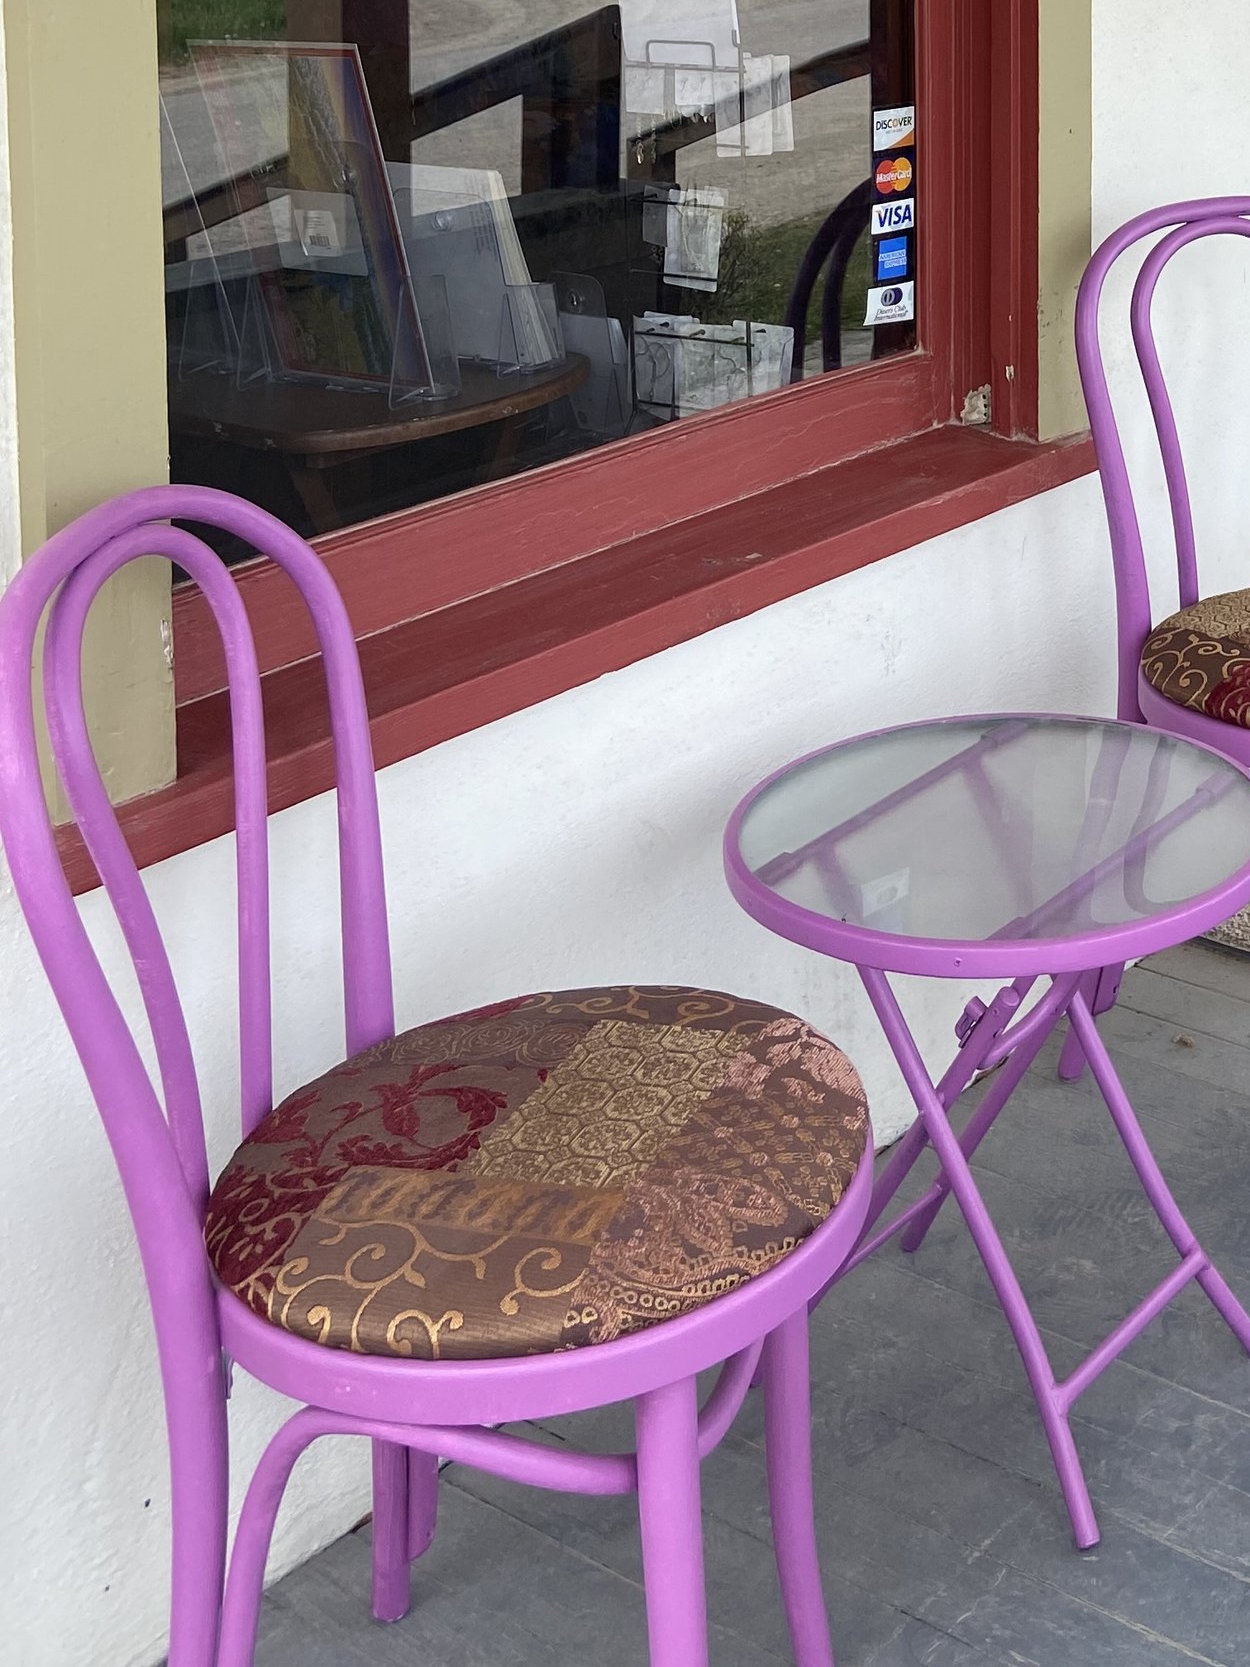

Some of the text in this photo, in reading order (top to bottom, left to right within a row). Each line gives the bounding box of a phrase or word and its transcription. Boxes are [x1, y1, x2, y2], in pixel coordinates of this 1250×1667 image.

[875, 116, 913, 131] DISCOVER
[875, 166, 913, 184] MasterCard
[875, 203, 912, 228] VISA
